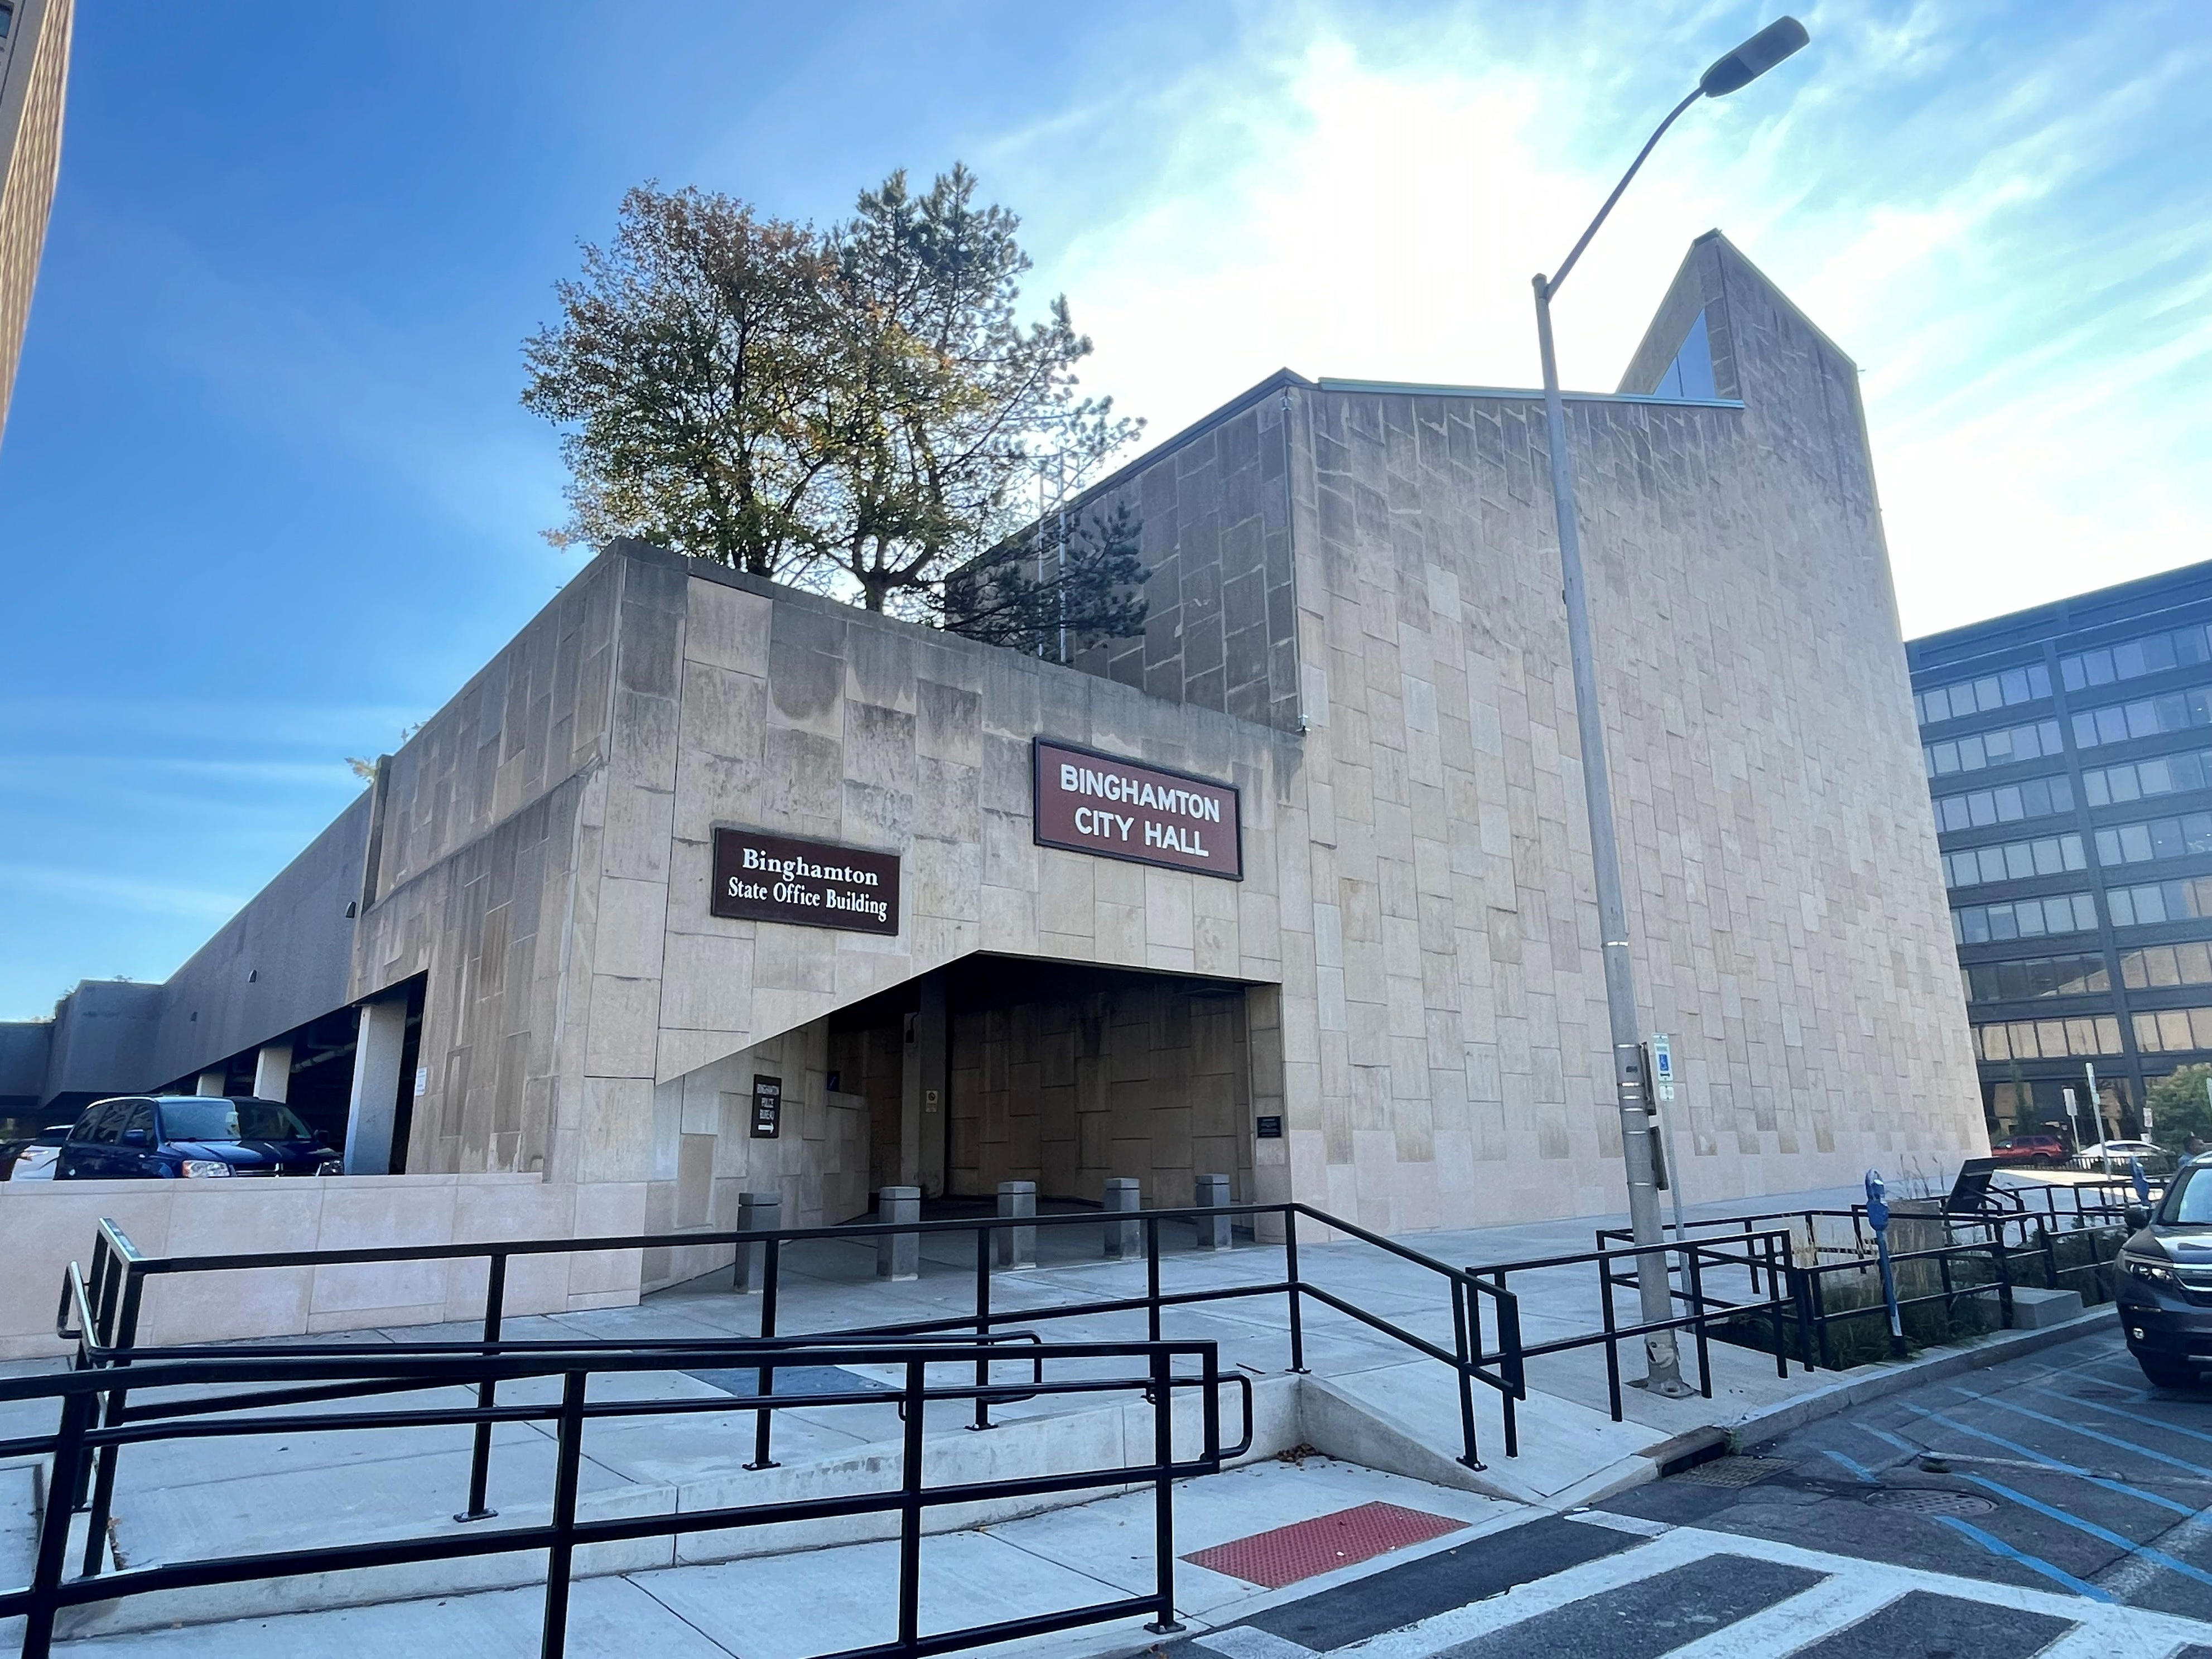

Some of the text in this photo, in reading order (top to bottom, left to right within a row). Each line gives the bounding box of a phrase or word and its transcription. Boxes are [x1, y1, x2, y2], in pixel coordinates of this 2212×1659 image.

[1060, 763, 1221, 823] BINGHAMTON
[1074, 806, 1209, 857] CITY HALL
[741, 847, 879, 886] Binghamton
[727, 876, 888, 923] State Office Building
